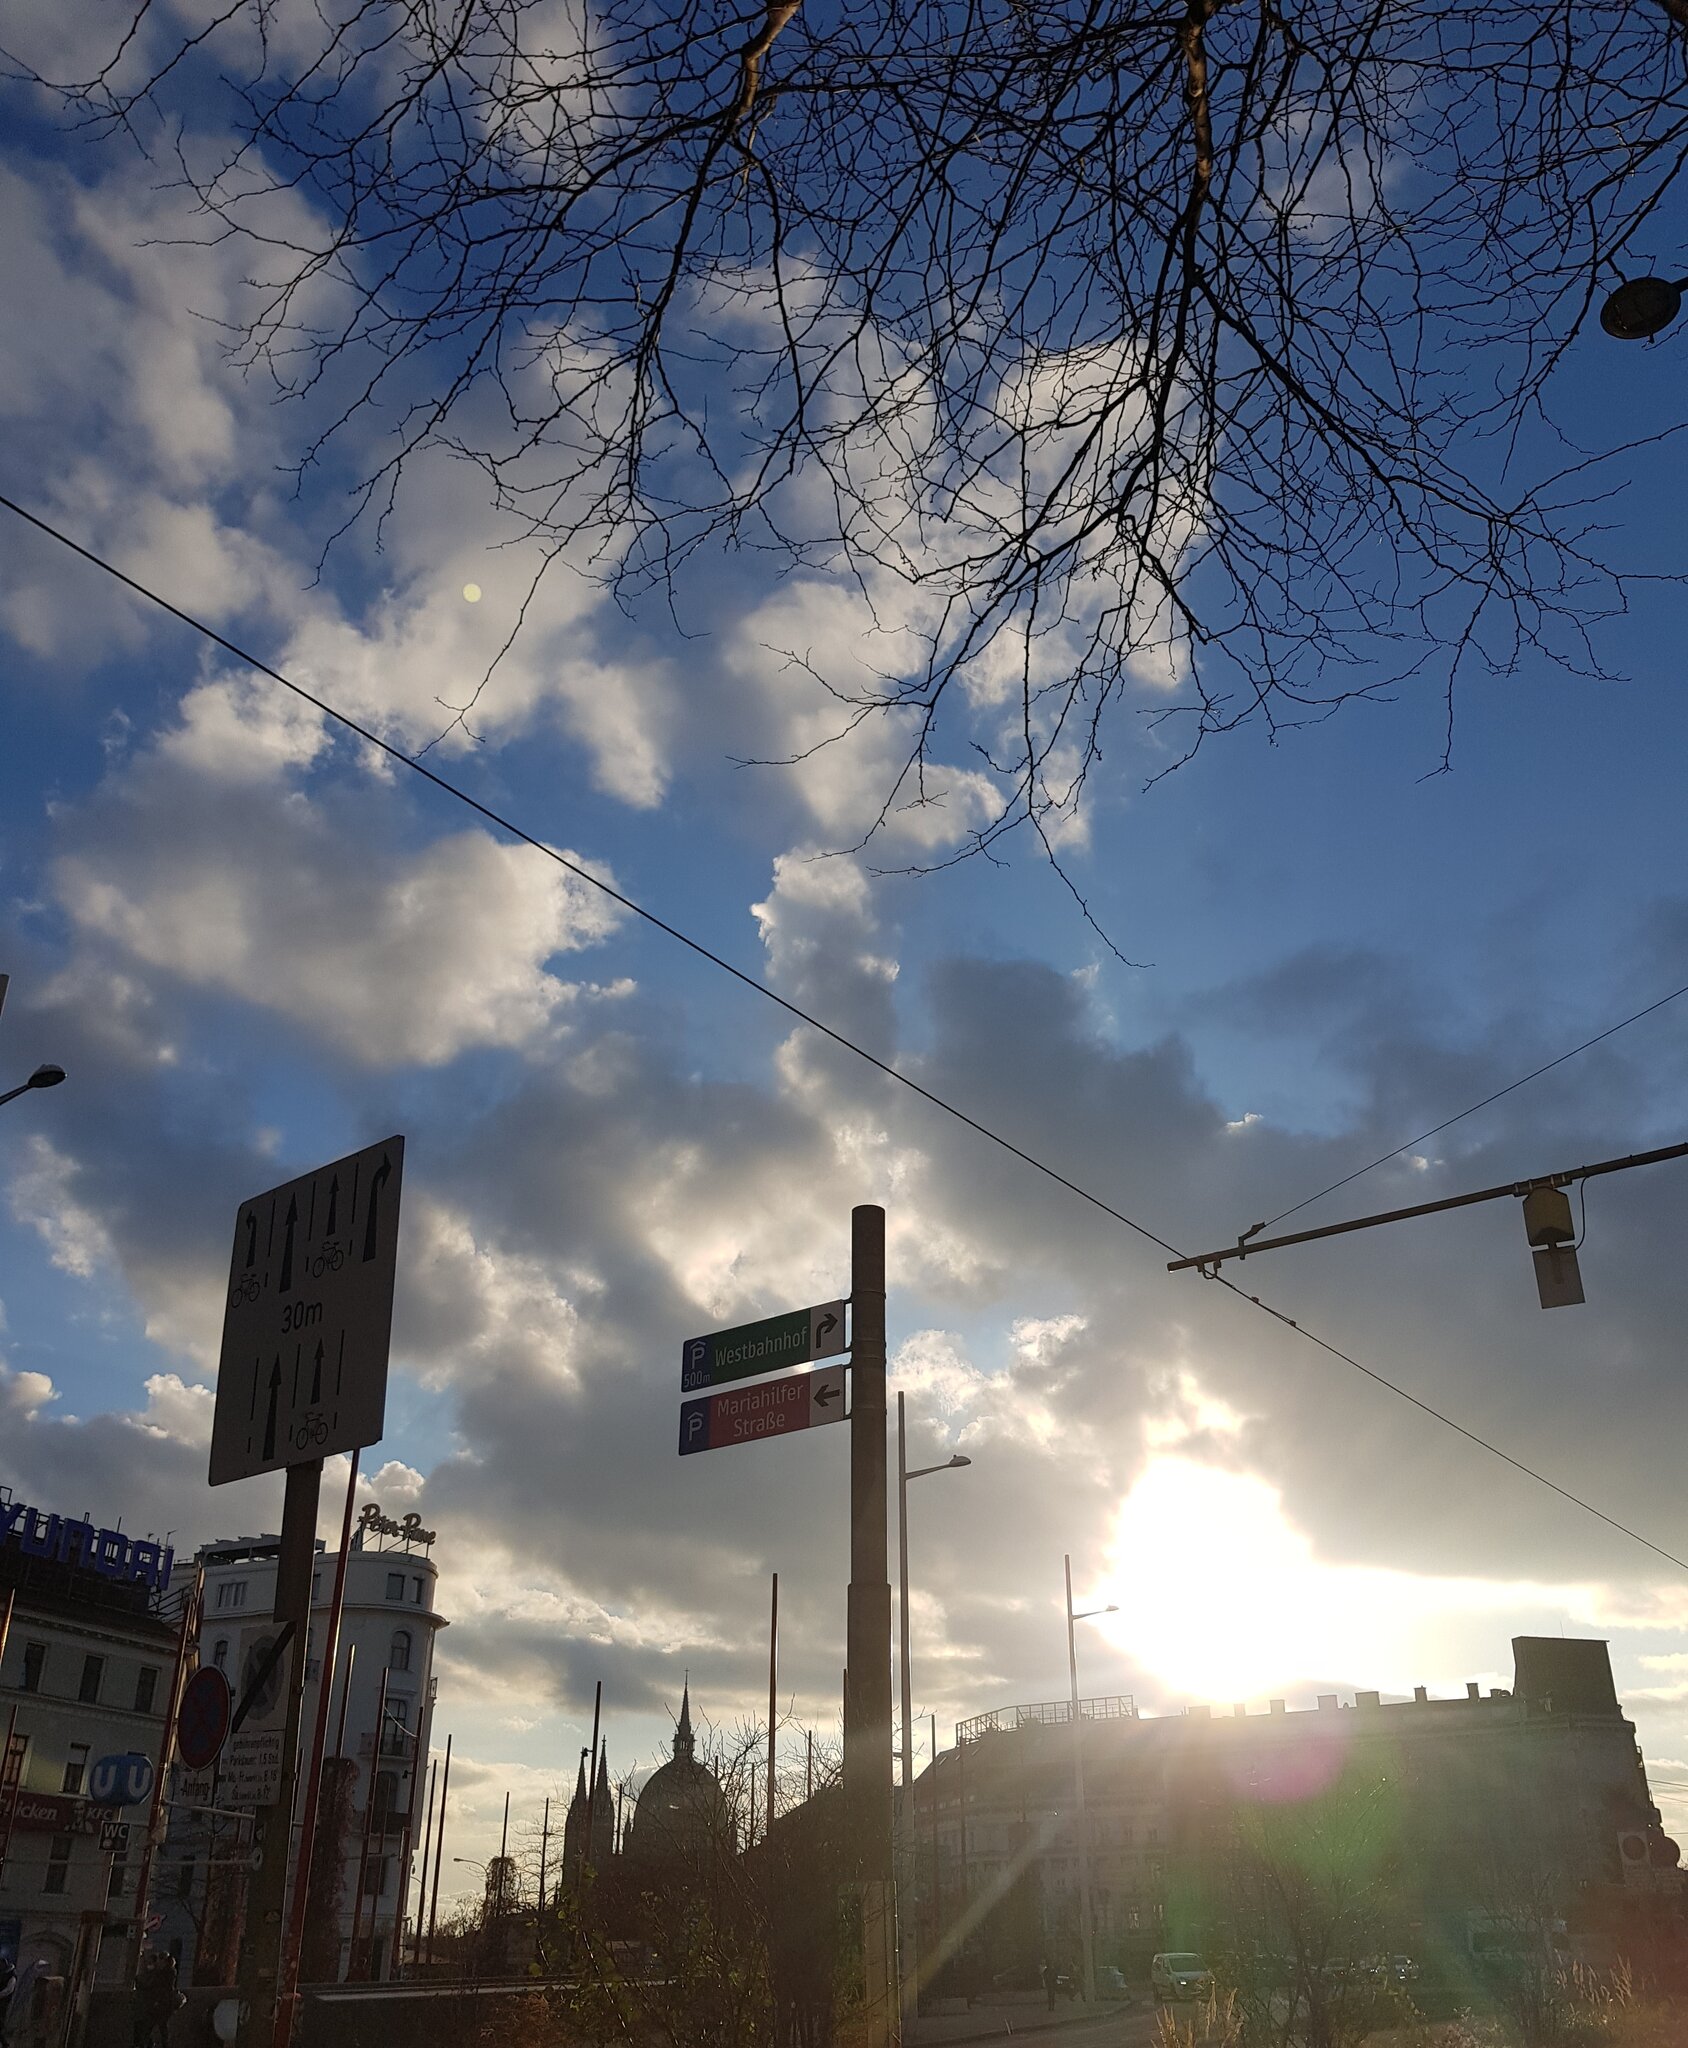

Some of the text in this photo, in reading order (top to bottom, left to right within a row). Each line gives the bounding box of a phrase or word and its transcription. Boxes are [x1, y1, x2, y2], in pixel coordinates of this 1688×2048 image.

[281, 1300, 322, 1333] 30m
[691, 1346, 706, 1369] P
[715, 1326, 808, 1367] Westbahnhof
[683, 1371, 711, 1388] 500m
[717, 1384, 804, 1417] Mariahilfer
[688, 1418, 703, 1442] P
[733, 1411, 785, 1437] Straße
[93, 1764, 118, 1797] U
[128, 1764, 151, 1797] U
[0, 1799, 113, 1821] icken KFC
[104, 1824, 129, 1839] WC
